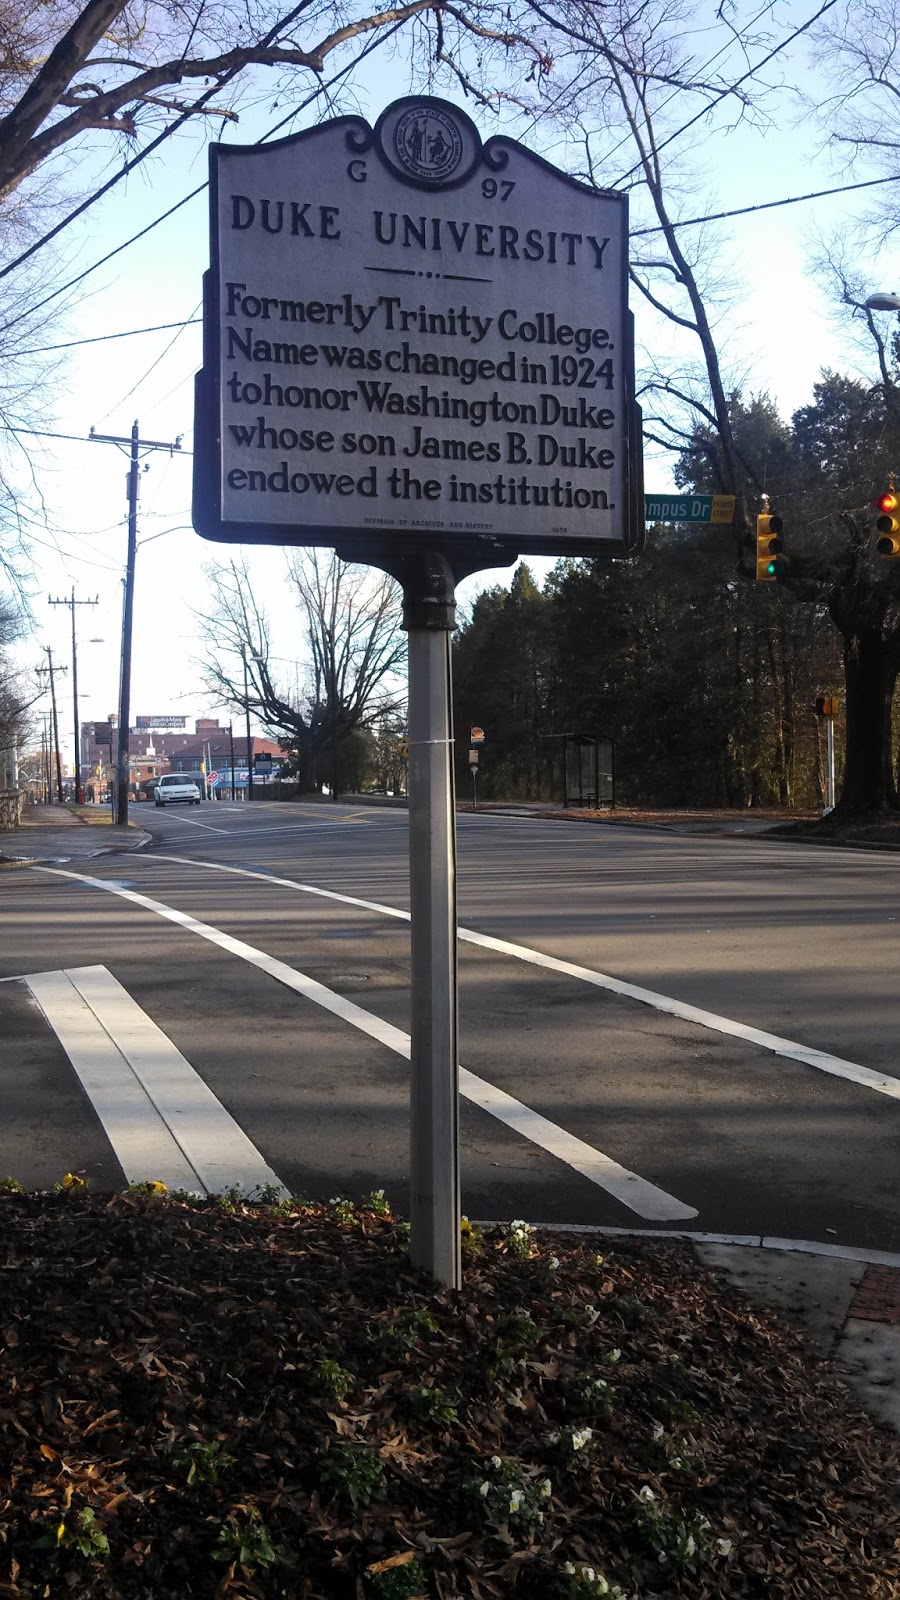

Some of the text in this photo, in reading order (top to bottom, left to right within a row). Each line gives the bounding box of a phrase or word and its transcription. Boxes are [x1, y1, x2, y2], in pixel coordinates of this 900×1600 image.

[347, 160, 367, 183] G
[481, 178, 516, 202] 97
[230, 194, 610, 270] DUKE UNIVERSITY
[225, 282, 615, 354] Formerly Trinity College.
[226, 327, 615, 390] Name was changed in 1924
[227, 372, 615, 429] to honor Washington Duke
[228, 417, 615, 469] whose son James B. Duke
[228, 462, 615, 509] endowed the institution.
[364, 517, 395, 525] DIVISION
[645, 501, 710, 520] mpus Dr
